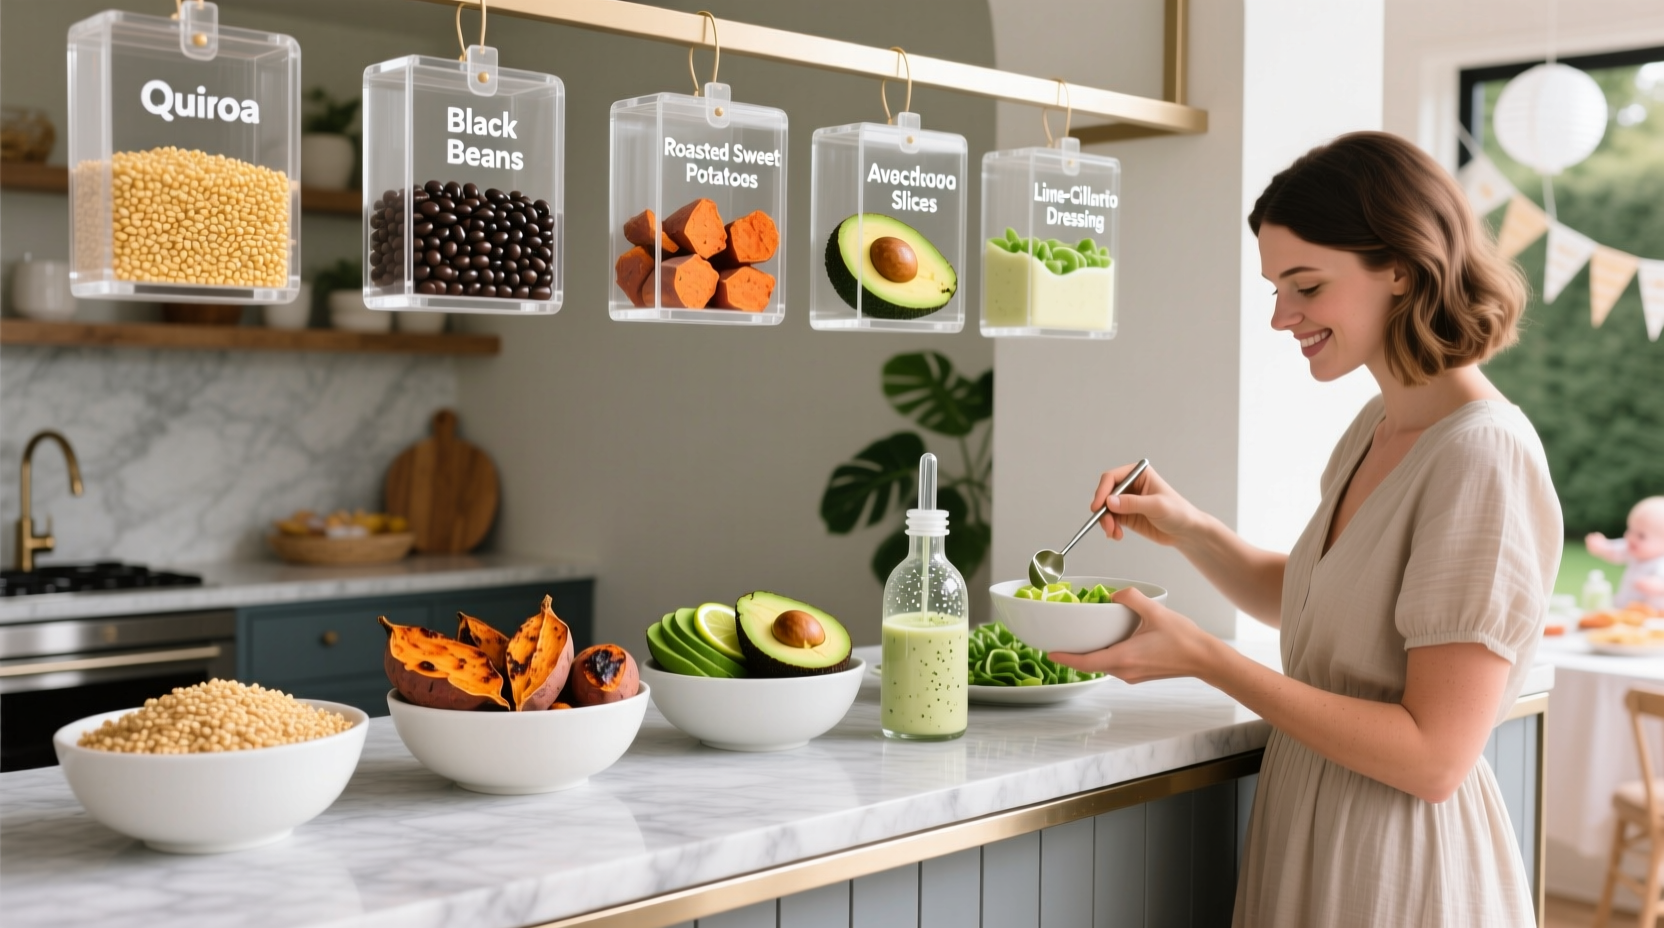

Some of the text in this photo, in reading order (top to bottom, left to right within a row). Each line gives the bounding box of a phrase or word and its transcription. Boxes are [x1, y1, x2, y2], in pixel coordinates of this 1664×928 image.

[448, 107, 517, 139] Black
[447, 139, 523, 171] Beans
[665, 137, 781, 167] Roasted Sweet
[892, 190, 937, 213] Slices
[1047, 206, 1104, 234] Dressing
